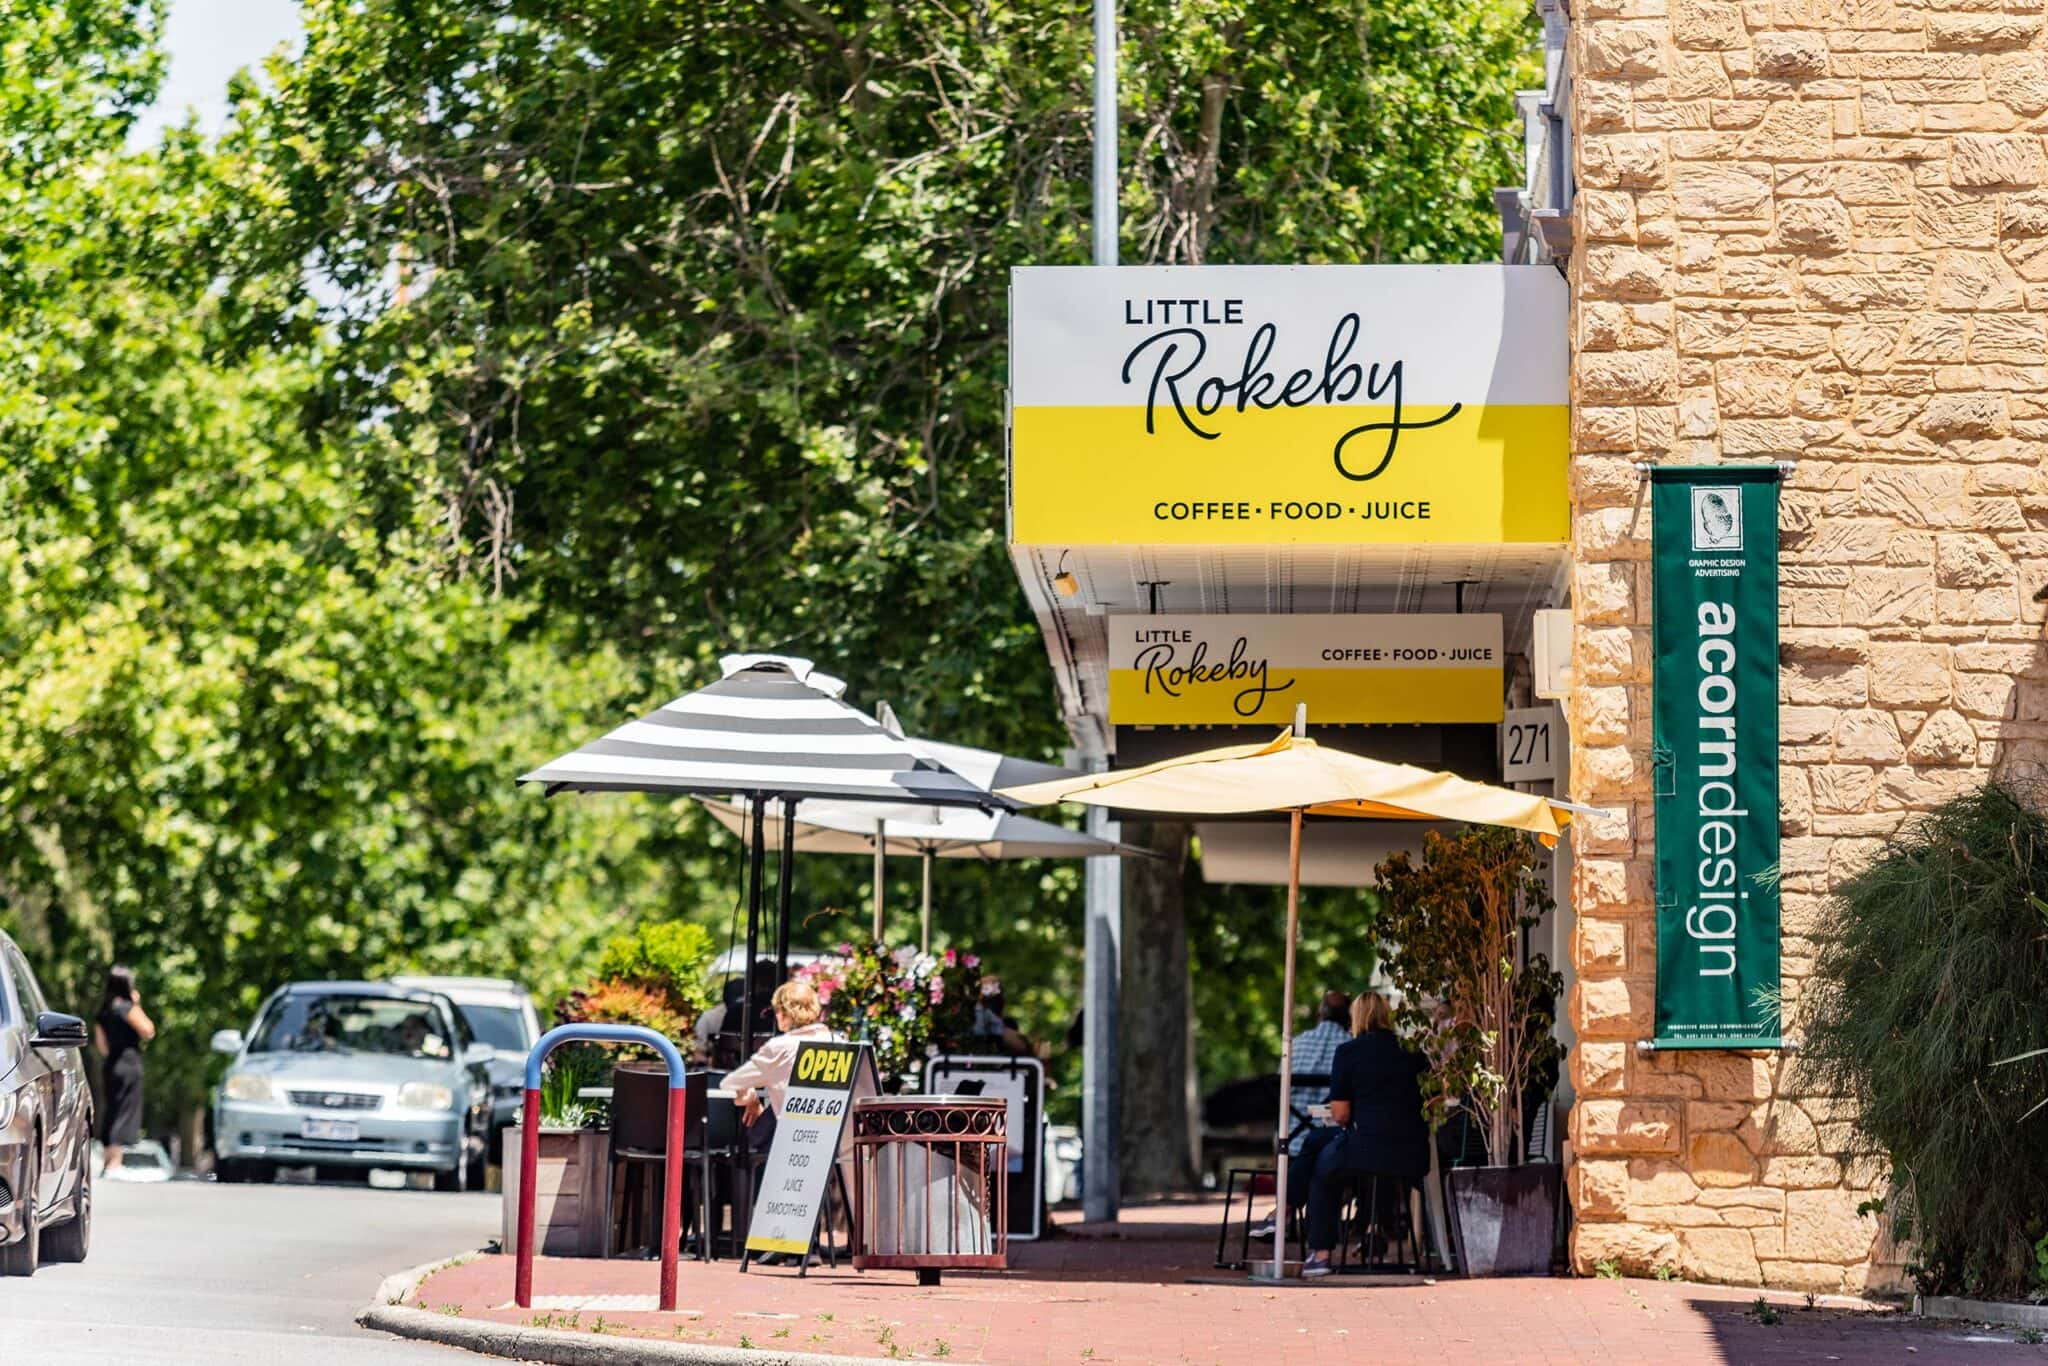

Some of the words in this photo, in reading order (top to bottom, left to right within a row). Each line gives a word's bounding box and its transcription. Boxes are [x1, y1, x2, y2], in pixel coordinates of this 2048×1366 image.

[1126, 299, 1243, 325] LITTLE
[1122, 312, 1461, 481] Rokeby
[1155, 502, 1250, 520] COFFEE
[1271, 502, 1342, 520] FOOD
[1362, 502, 1431, 520] JUICE
[1688, 559, 1719, 567] GRAPHIC
[1720, 559, 1746, 567] DESIGN
[1695, 568, 1740, 577] ADVERTISING
[1135, 630, 1192, 643] LITTLE
[1321, 648, 1381, 661] COFFEE
[1393, 648, 1438, 661] FOOD
[1449, 648, 1492, 661] JUICE
[1134, 636, 1295, 717] Rokeby
[1508, 723, 1550, 766] 271
[798, 1048, 853, 1083] OPEN
[786, 1097, 815, 1115] GRAB
[816, 1099, 825, 1115] &
[826, 1099, 842, 1116] GO
[792, 1129, 820, 1144] COFFEE
[788, 1153, 810, 1168] FOOD
[782, 1178, 804, 1193] JUICE
[766, 1202, 807, 1217] SMOOTHIES
